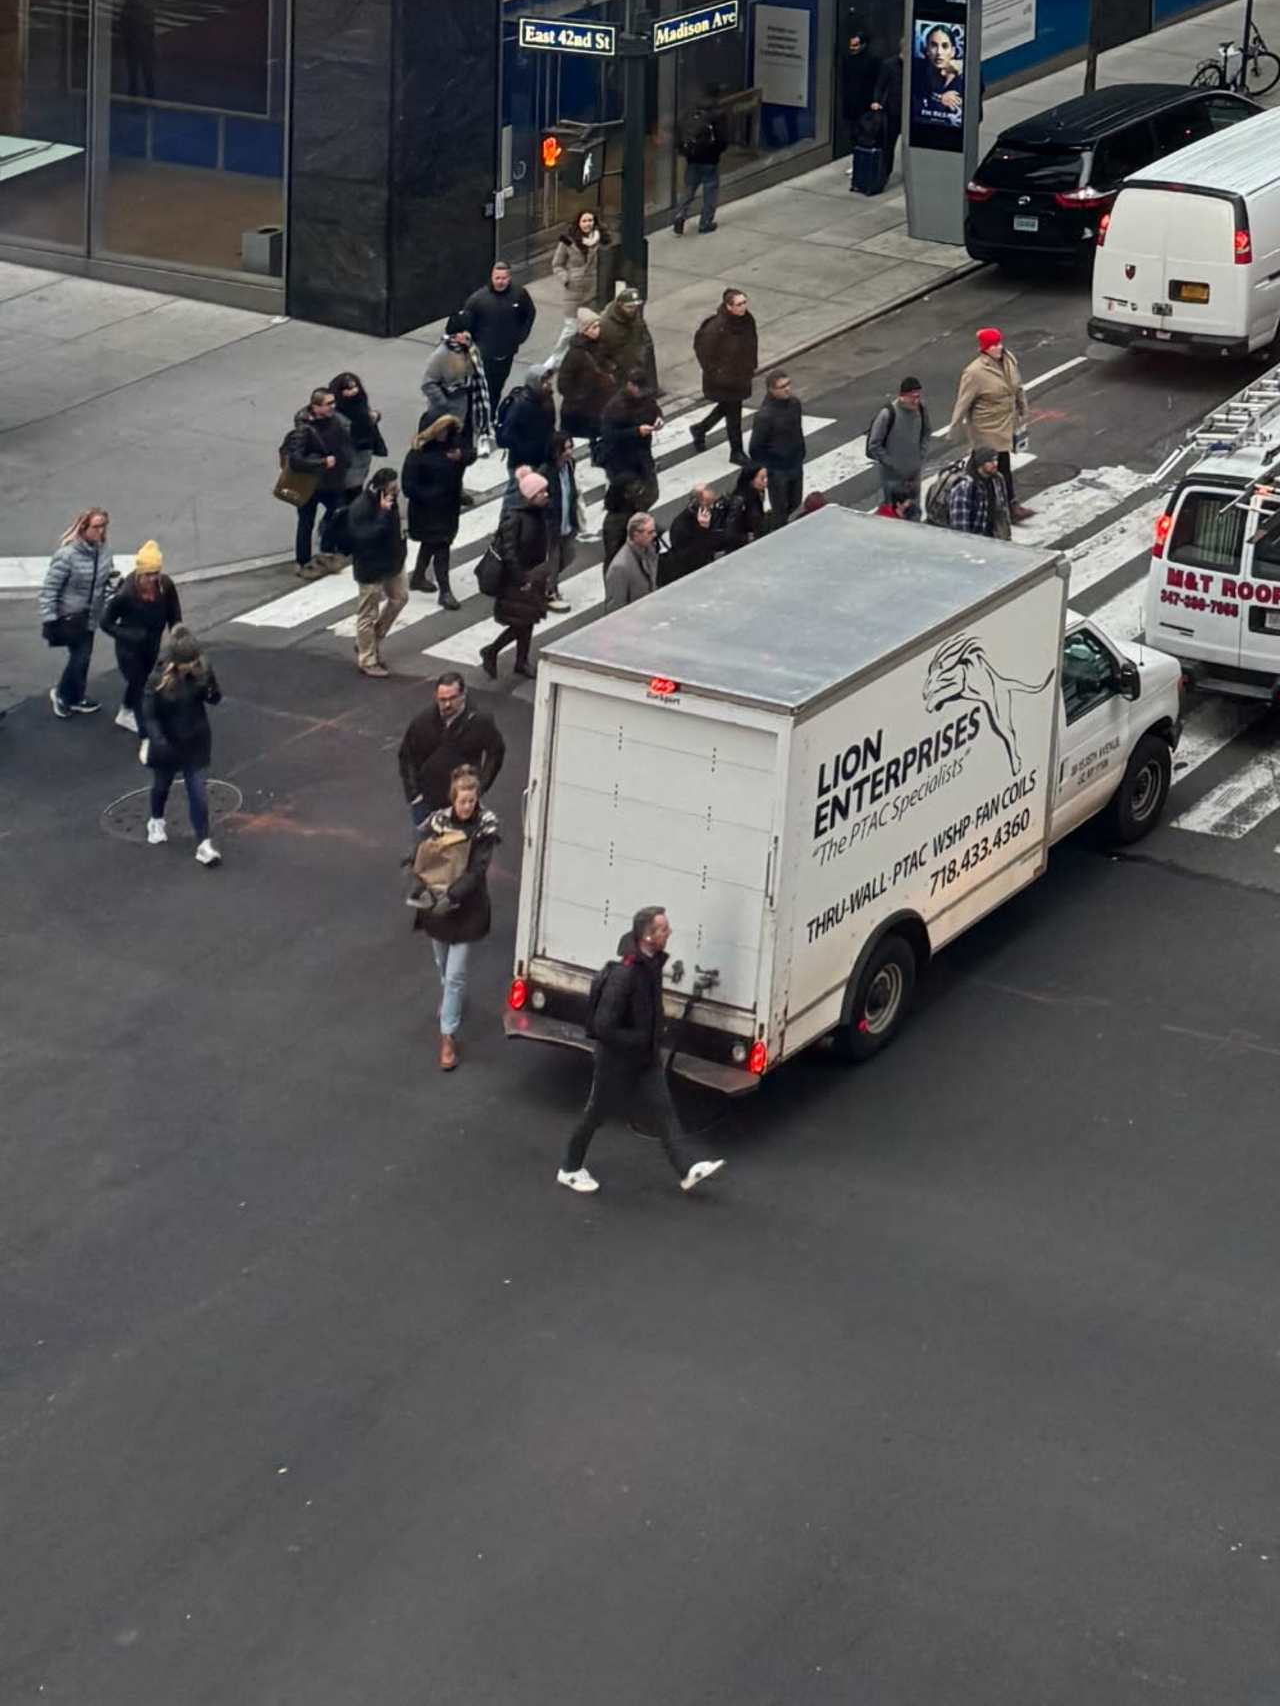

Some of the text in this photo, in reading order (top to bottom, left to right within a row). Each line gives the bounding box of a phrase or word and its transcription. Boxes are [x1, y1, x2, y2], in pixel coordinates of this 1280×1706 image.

[525, 26, 610, 50] East 42nd St
[655, 12, 736, 46] Madison Ave
[1166, 567, 1214, 593] M&T
[814, 707, 980, 839] ENTERPRISES
[817, 729, 883, 799] LION
[1001, 769, 1037, 811] COILS
[849, 804, 888, 847] PTAC
[929, 808, 1030, 898] 718.433.4360
